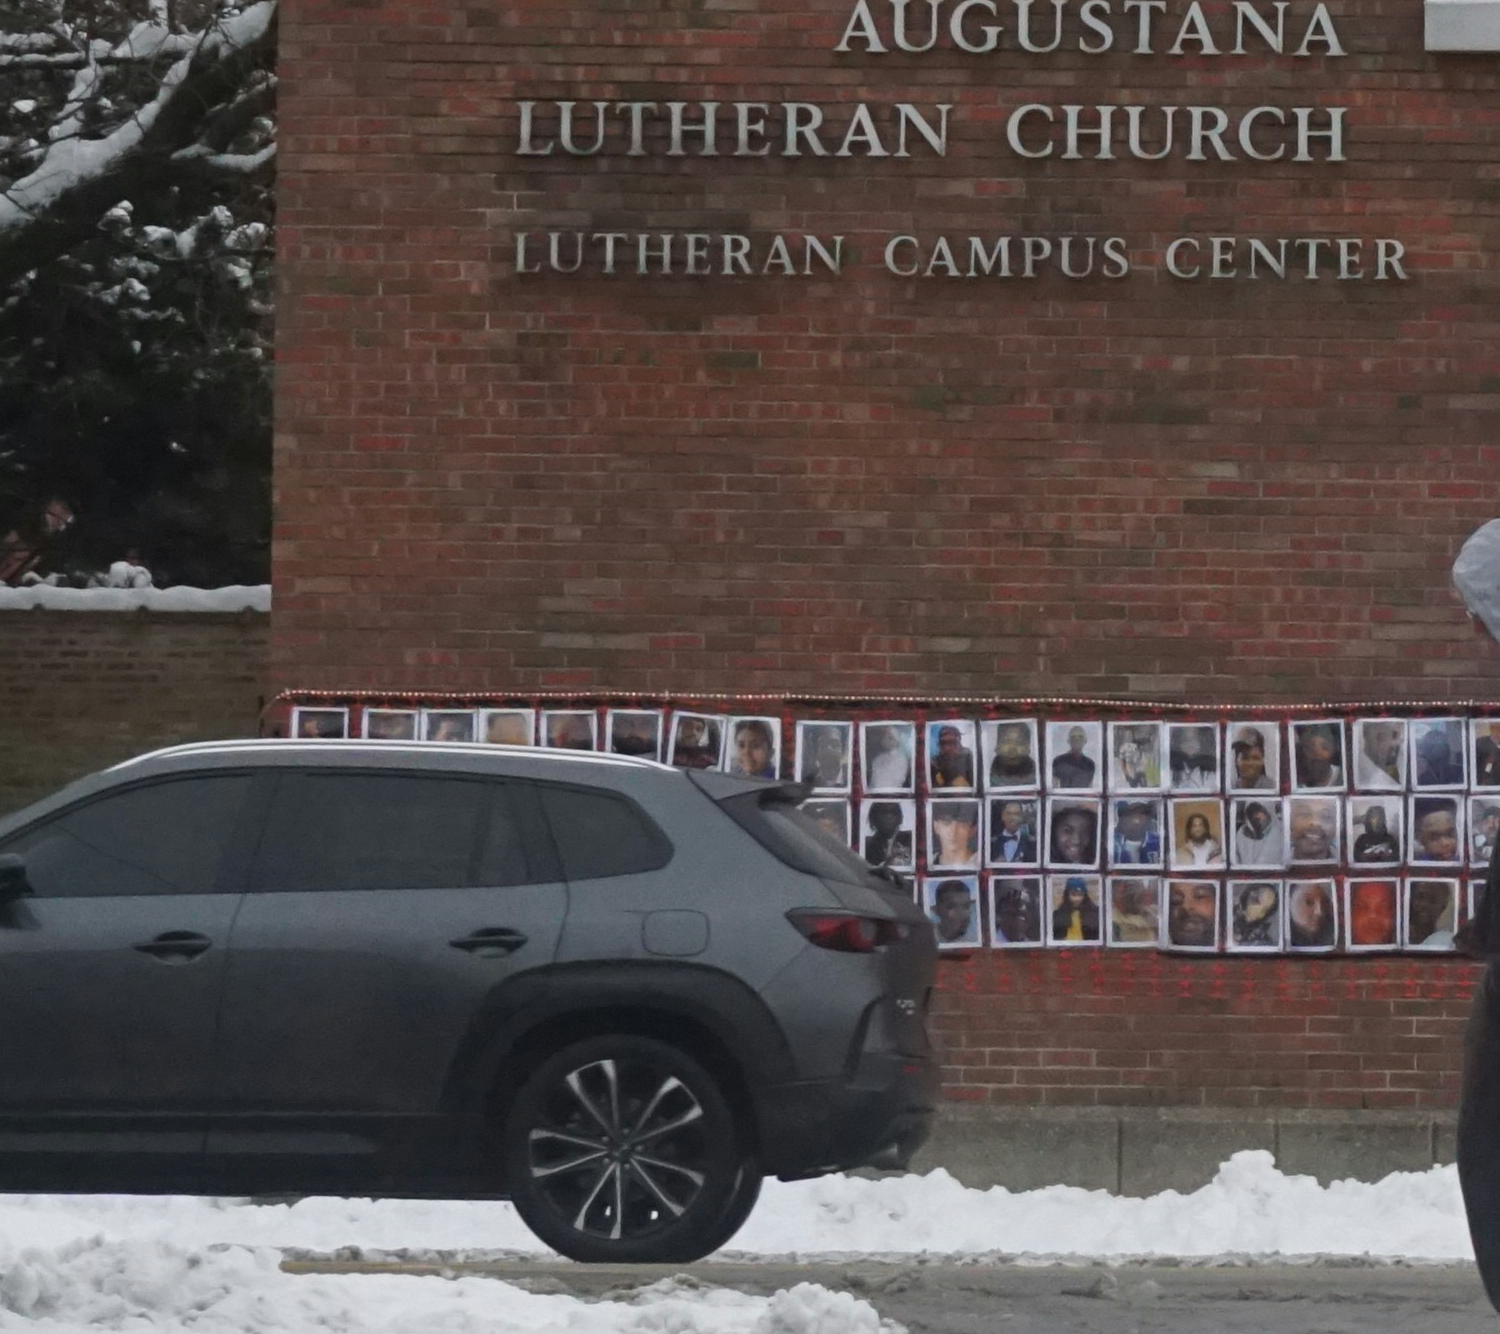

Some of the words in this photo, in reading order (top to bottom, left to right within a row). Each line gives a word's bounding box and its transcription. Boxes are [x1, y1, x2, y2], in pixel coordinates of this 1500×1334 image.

[514, 100, 953, 159] LUTHERAN
[1005, 103, 1348, 162] CHURCH
[512, 232, 844, 276] LUTHERAN
[884, 235, 1130, 280] CAMPUS
[1164, 237, 1409, 282] CENTER
